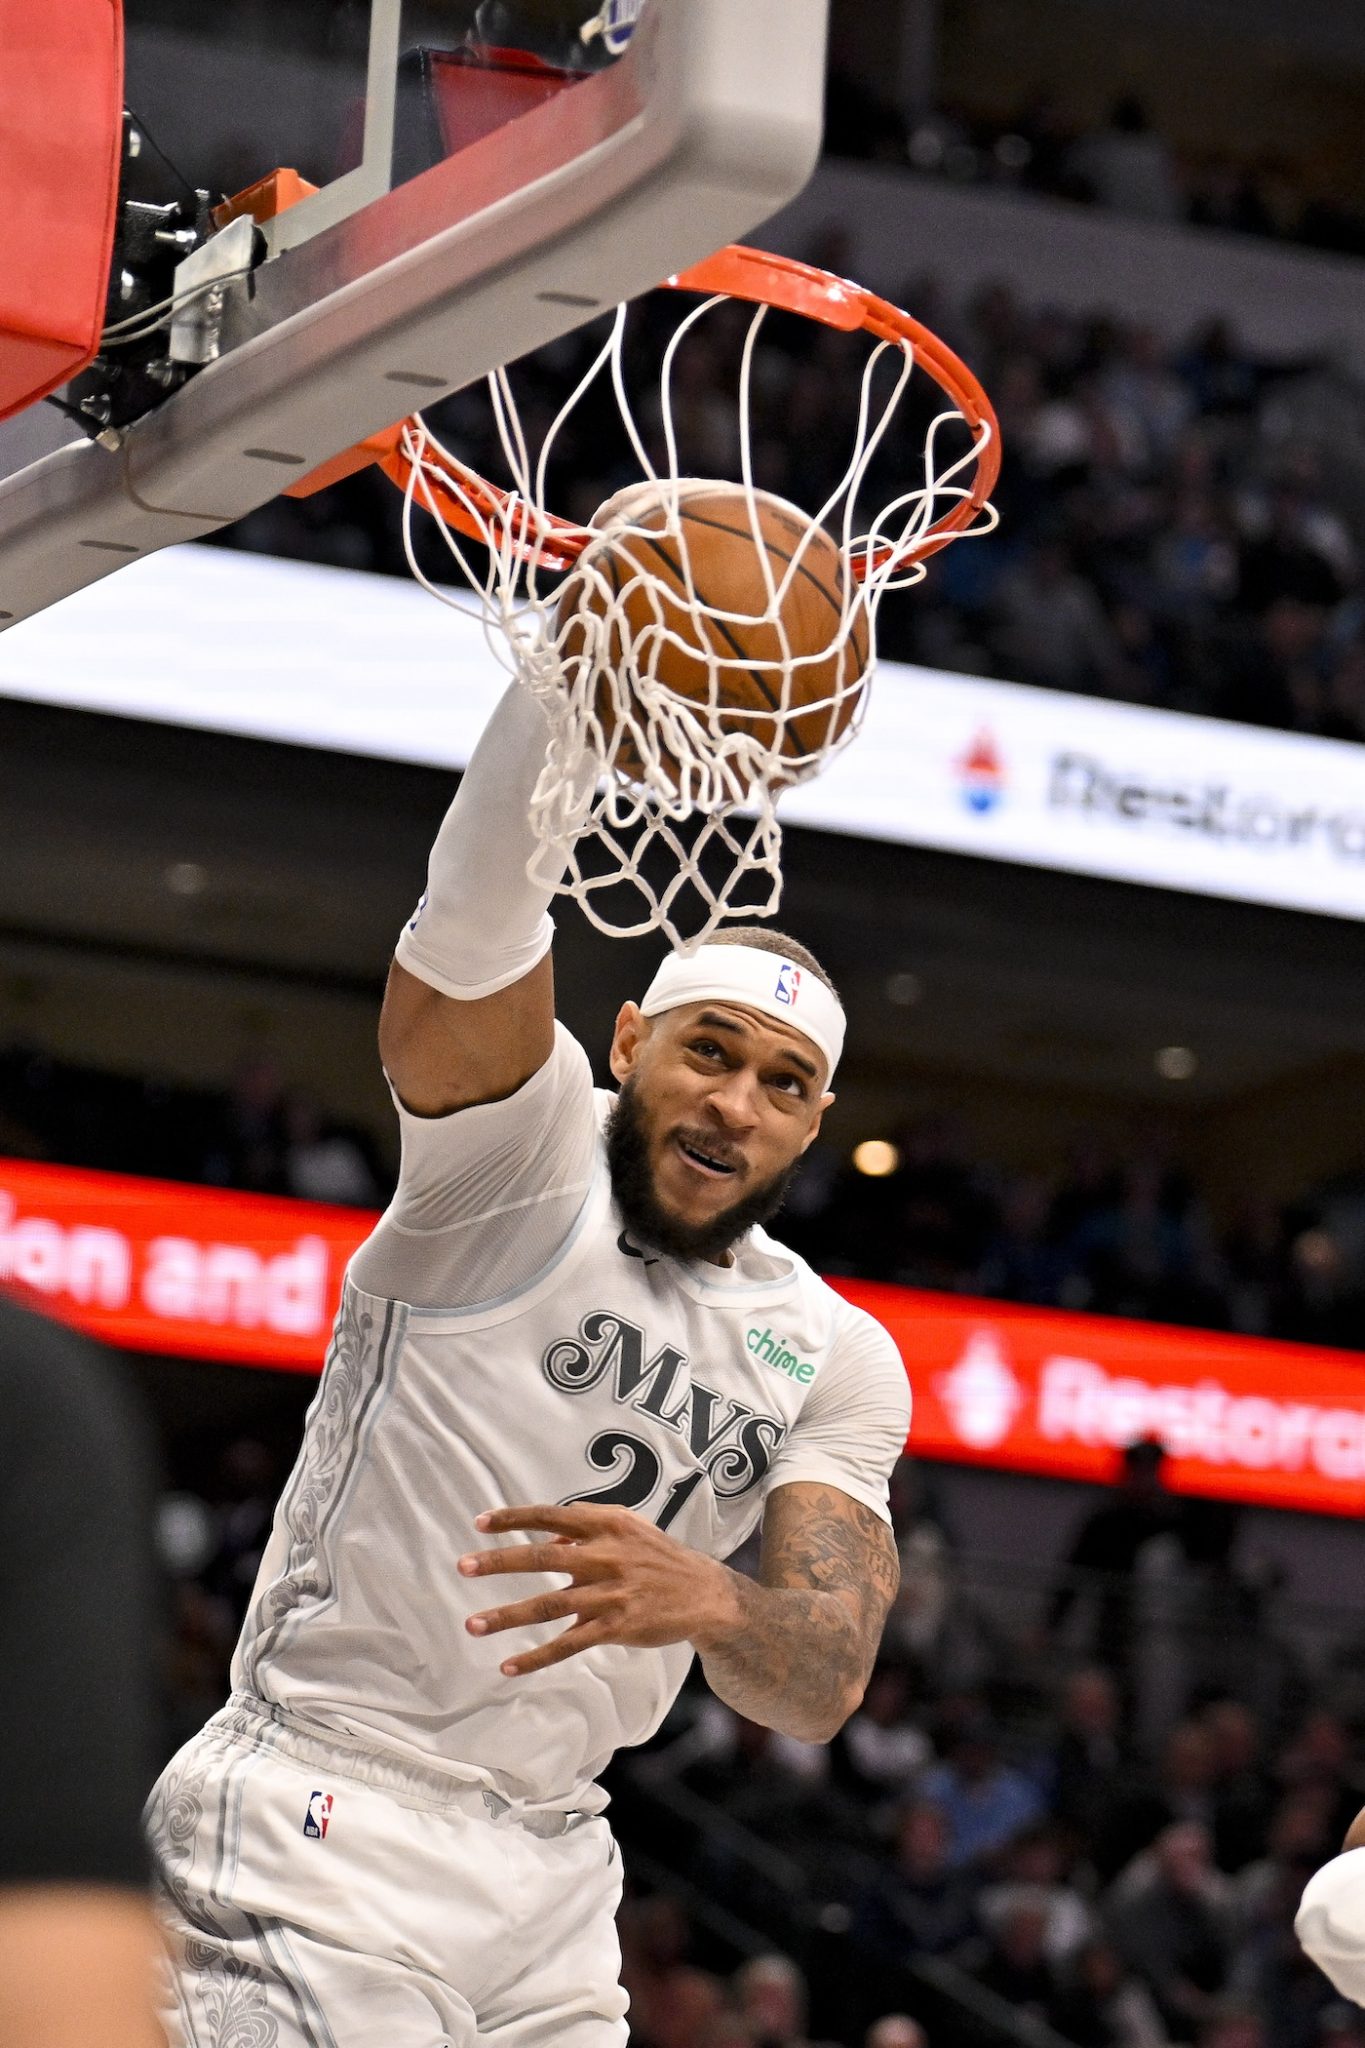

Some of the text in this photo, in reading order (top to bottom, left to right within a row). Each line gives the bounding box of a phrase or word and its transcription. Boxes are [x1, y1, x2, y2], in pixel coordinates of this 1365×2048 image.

[143, 1234, 327, 1335] and
[747, 1328, 816, 1384] chime
[556, 1429, 707, 1532] 21
